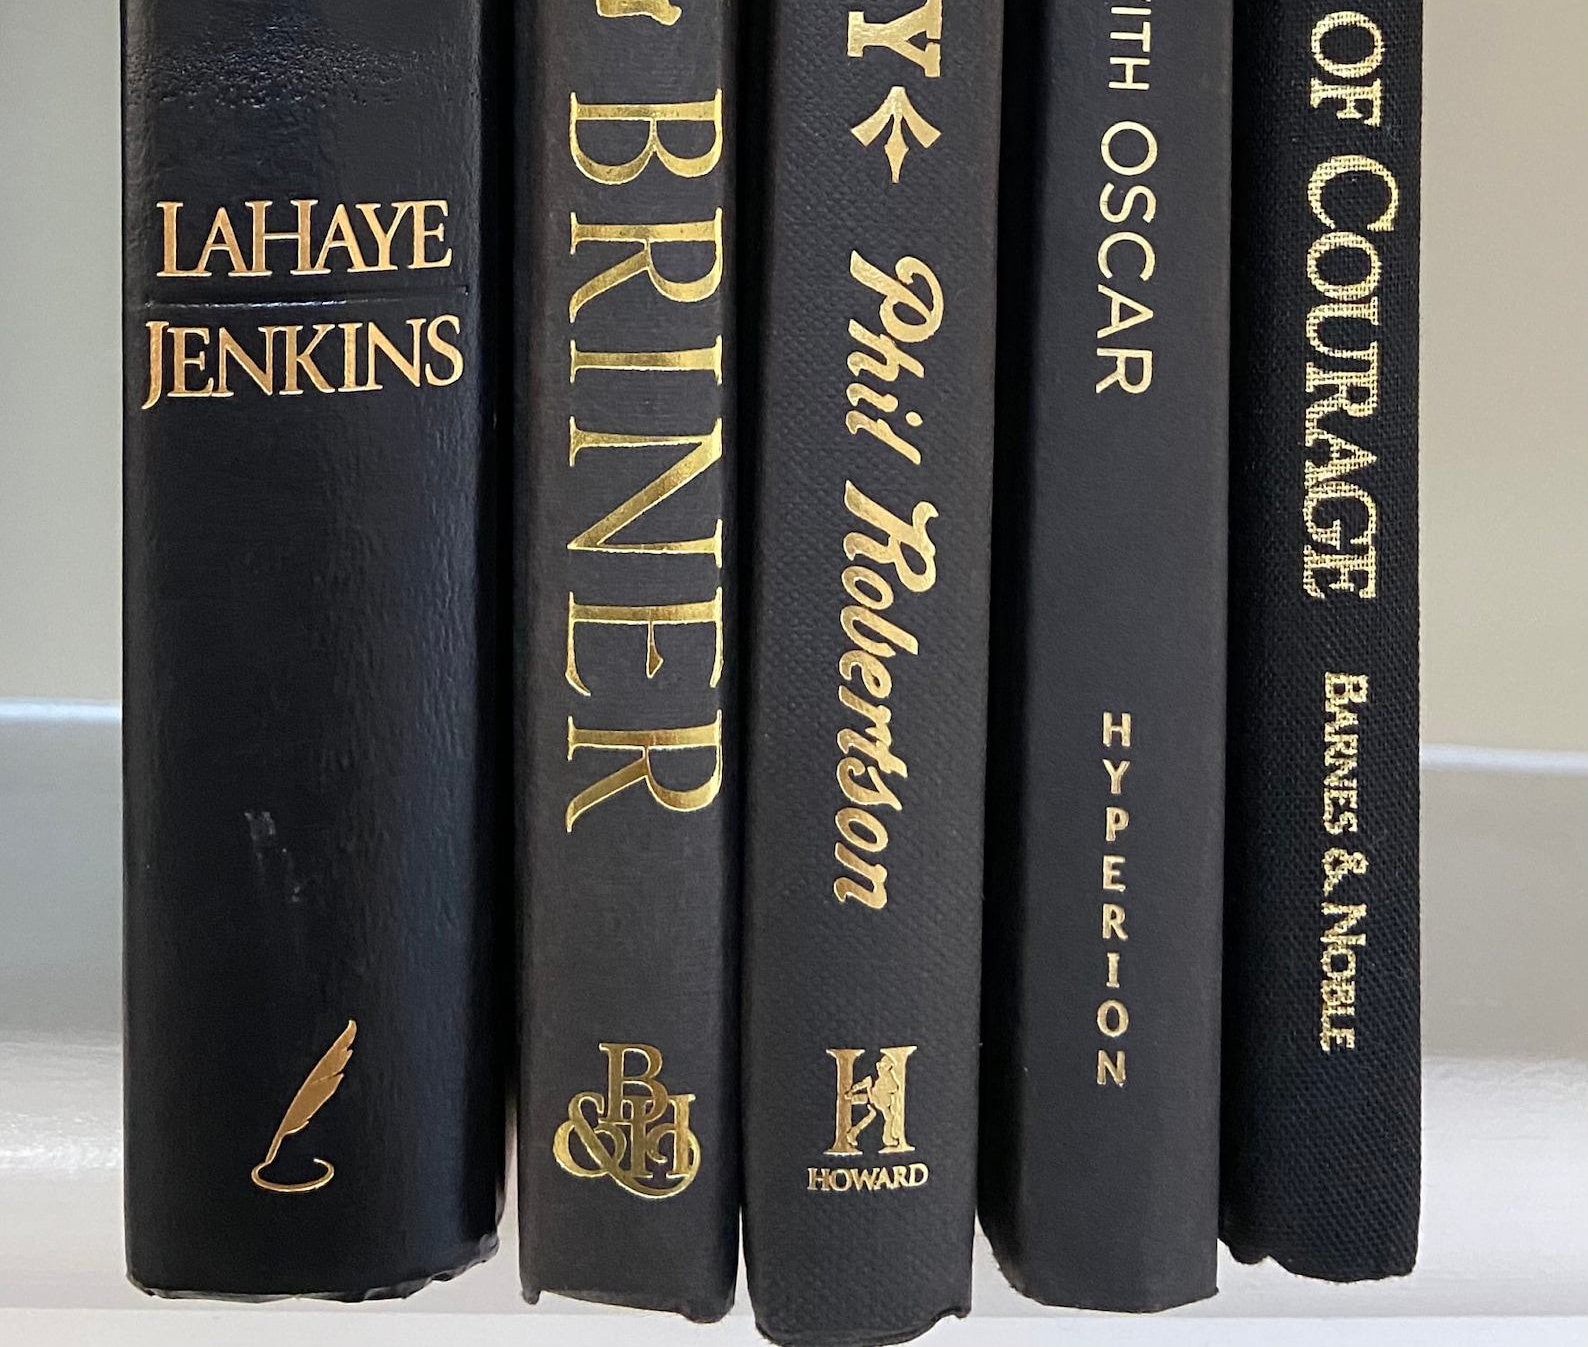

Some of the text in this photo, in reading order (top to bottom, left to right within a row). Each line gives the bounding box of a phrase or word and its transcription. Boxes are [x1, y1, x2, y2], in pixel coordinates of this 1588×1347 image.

[1095, 120, 1158, 394] OSCAR
[1308, 10, 1386, 128] OF
[142, 314, 465, 410] JENKINS
[567, 88, 725, 833] BRINER
[1302, 154, 1400, 599] COURAGE
[834, 249, 944, 910] Phil Robertson
[1096, 711, 1132, 1088] HYPERION
[1319, 672, 1369, 1053] BARNES & NOBLE
[806, 1162, 930, 1193] HOWARD
